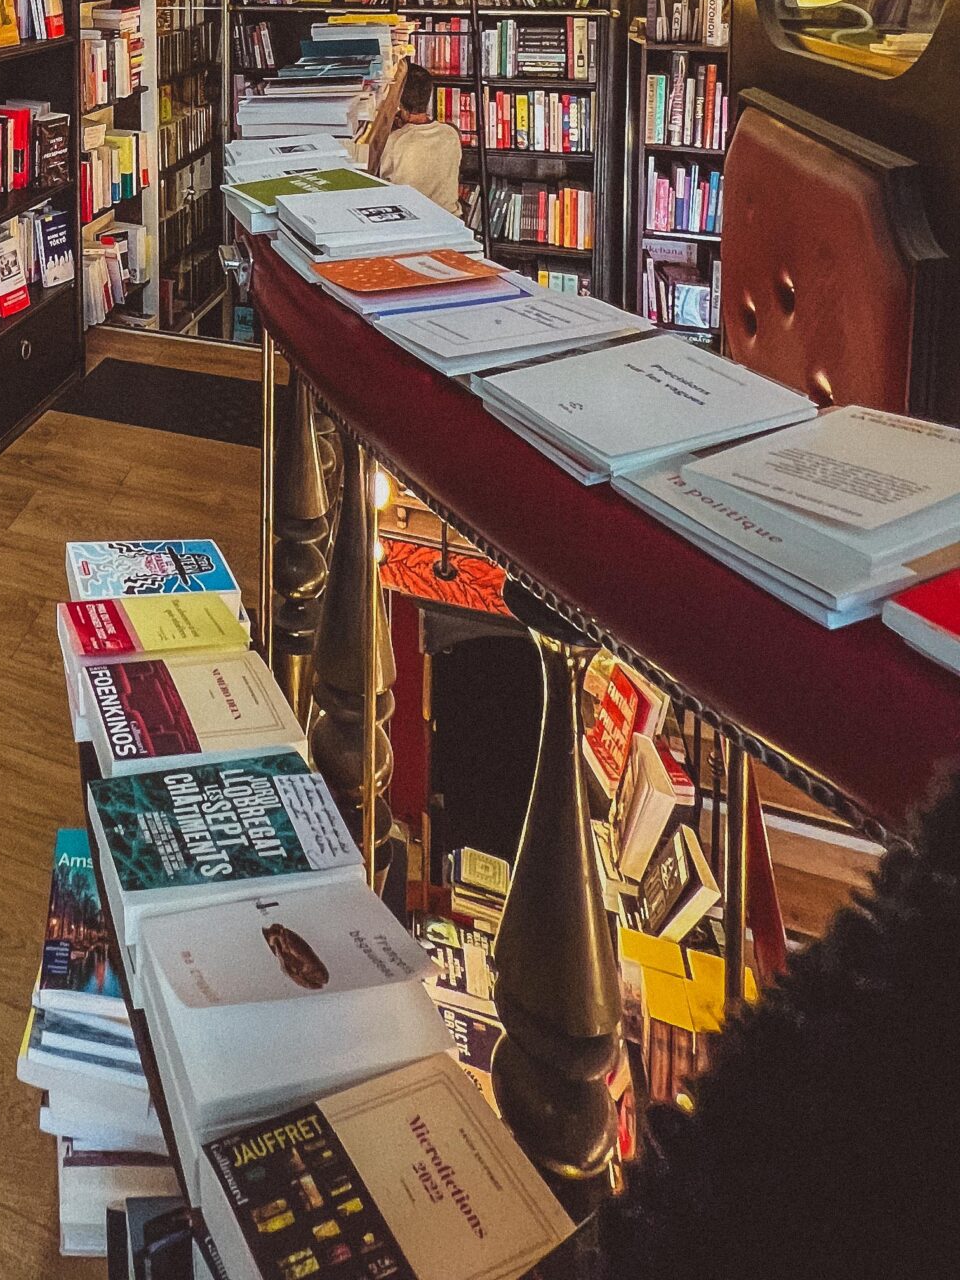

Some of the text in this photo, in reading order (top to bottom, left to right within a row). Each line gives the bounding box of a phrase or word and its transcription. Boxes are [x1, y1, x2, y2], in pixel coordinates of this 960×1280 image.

[645, 372, 662, 384] les
[665, 383, 706, 406] vagues
[666, 475, 687, 488] la
[685, 484, 784, 544] politique
[90, 669, 137, 757] FOENKINOS
[163, 772, 233, 877] CHÂTIMENTS
[201, 784, 249, 847] LES SEPT
[219, 768, 288, 858] LLOBREGAT
[249, 777, 282, 809] JORDI
[233, 1113, 324, 1168] JAUFFRET
[409, 1113, 488, 1240] Microfictions
[410, 1160, 445, 1204] 2022
